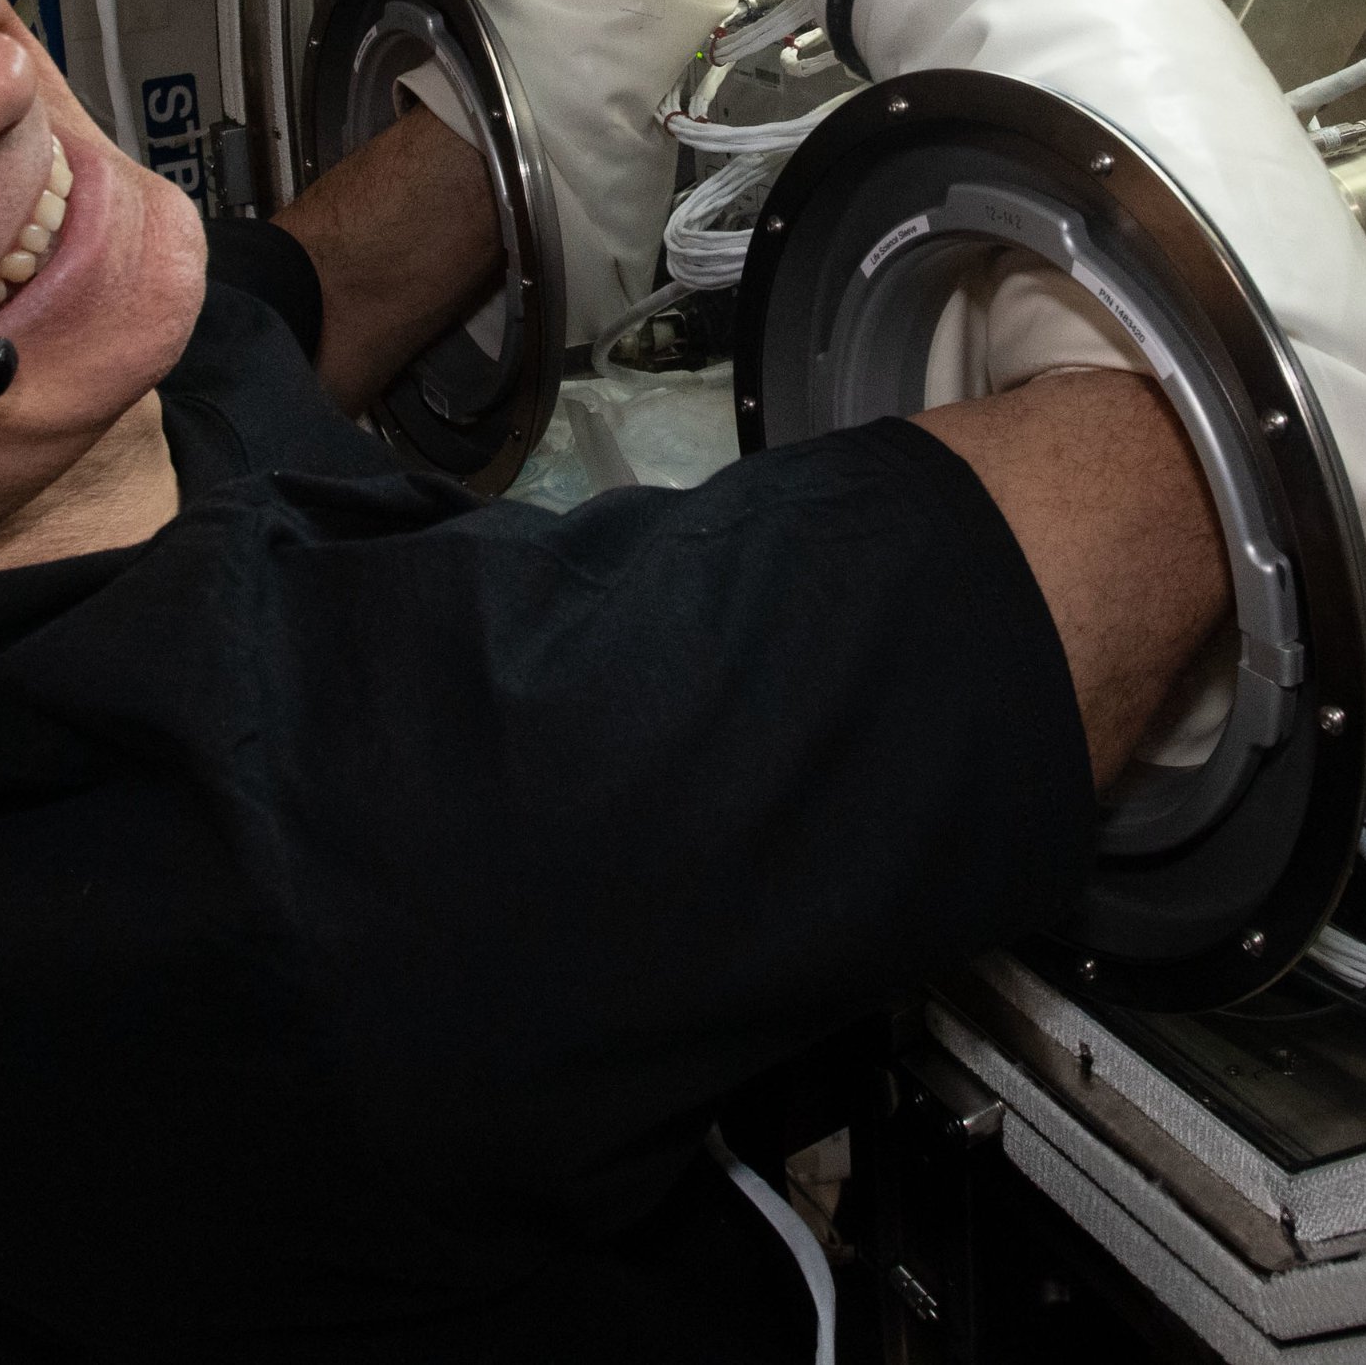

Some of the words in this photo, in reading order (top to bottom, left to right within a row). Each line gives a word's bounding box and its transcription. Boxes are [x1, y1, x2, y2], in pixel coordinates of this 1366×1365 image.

[869, 248, 883, 266] Life
[897, 223, 919, 243] Sleeve
[1098, 287, 1114, 308] P/N
